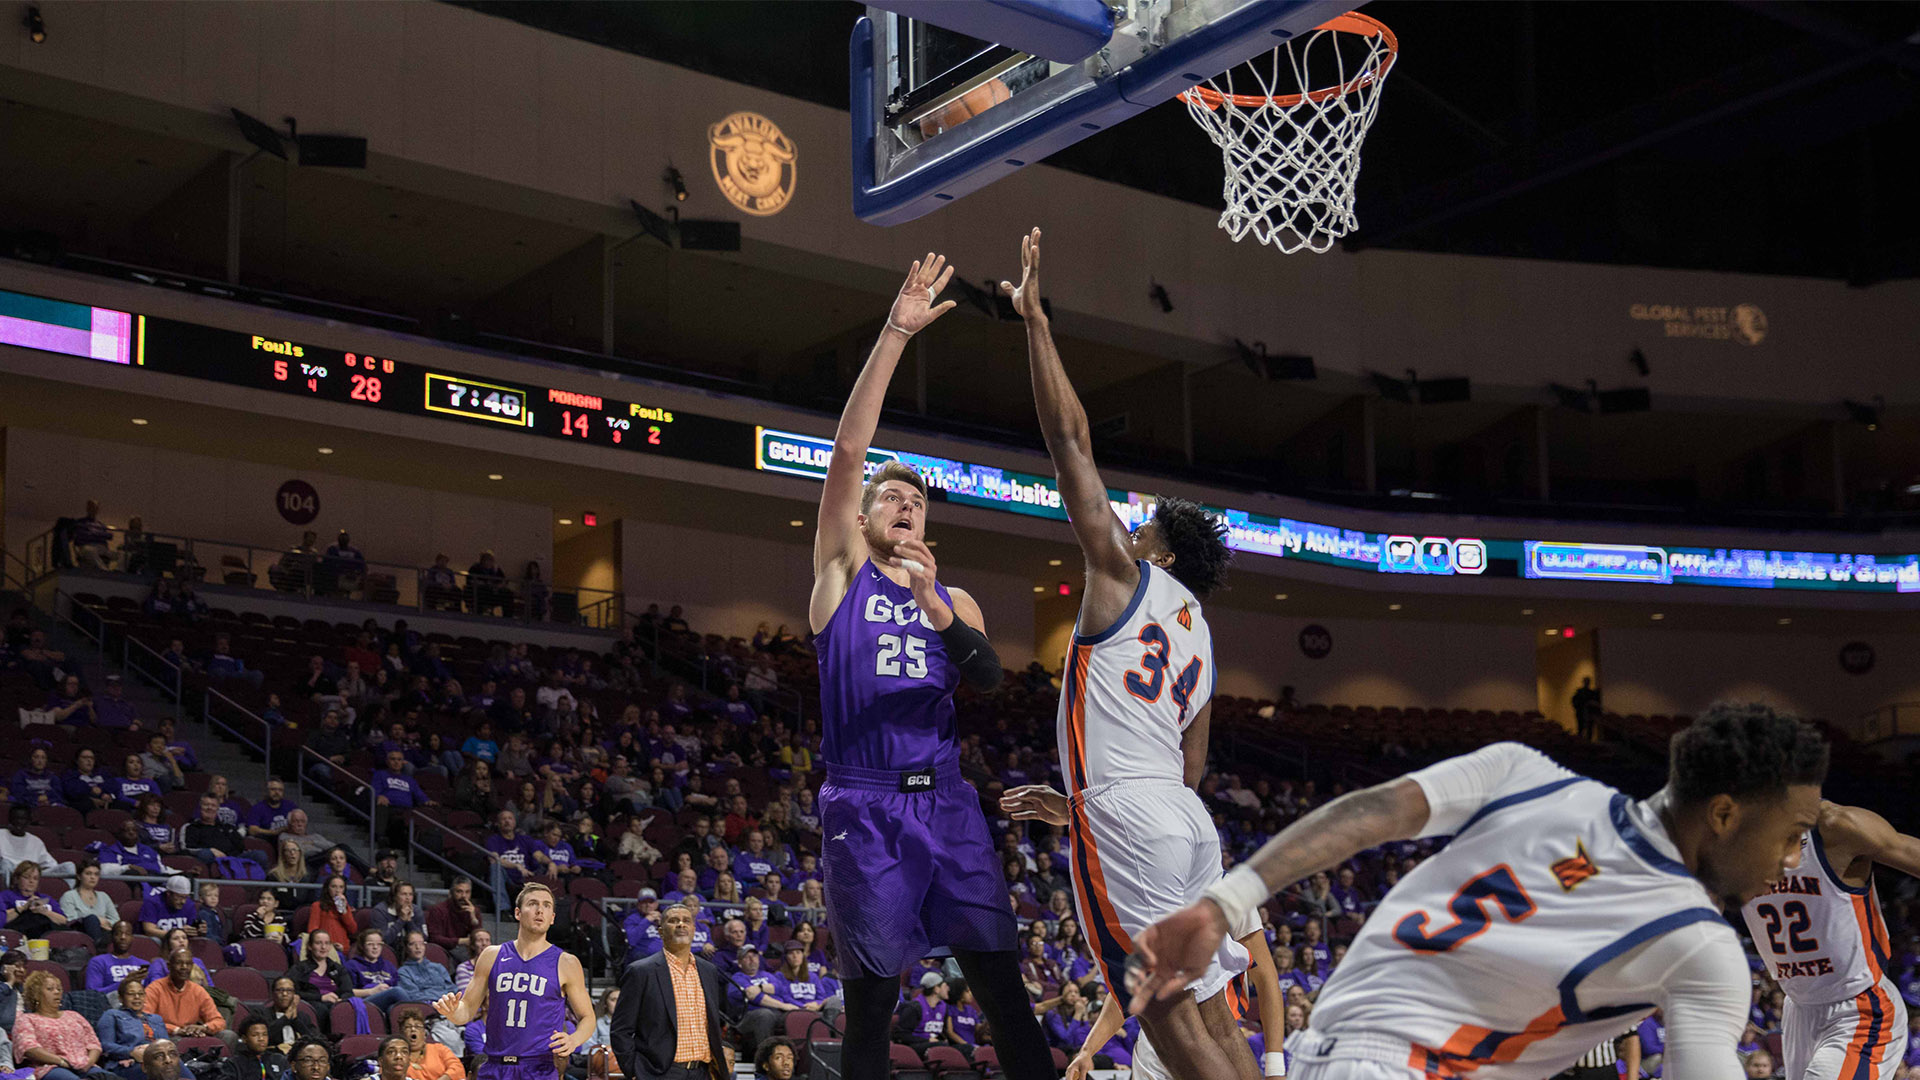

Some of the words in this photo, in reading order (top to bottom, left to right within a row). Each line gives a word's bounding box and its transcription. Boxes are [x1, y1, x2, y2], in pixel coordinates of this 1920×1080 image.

[252, 335, 304, 358] Fouls
[273, 360, 288, 381] 5
[300, 363, 328, 378] T/O
[307, 378, 317, 393] 4
[350, 374, 382, 403] 28
[548, 389, 603, 411] MORGAN
[561, 410, 589, 438] 14
[605, 416, 630, 431] T/O
[629, 403, 674, 424] Fouls
[648, 425, 661, 445] 2
[982, 474, 1061, 508] Website
[281, 492, 316, 514] 104
[875, 633, 929, 679] 25
[1122, 622, 1204, 726] 34
[906, 775, 931, 787] GCU
[1391, 861, 1538, 956] 5
[1756, 900, 1820, 956] 22
[495, 971, 548, 997] GCU
[505, 998, 528, 1029] 11
[503, 1055, 518, 1064] GCU
